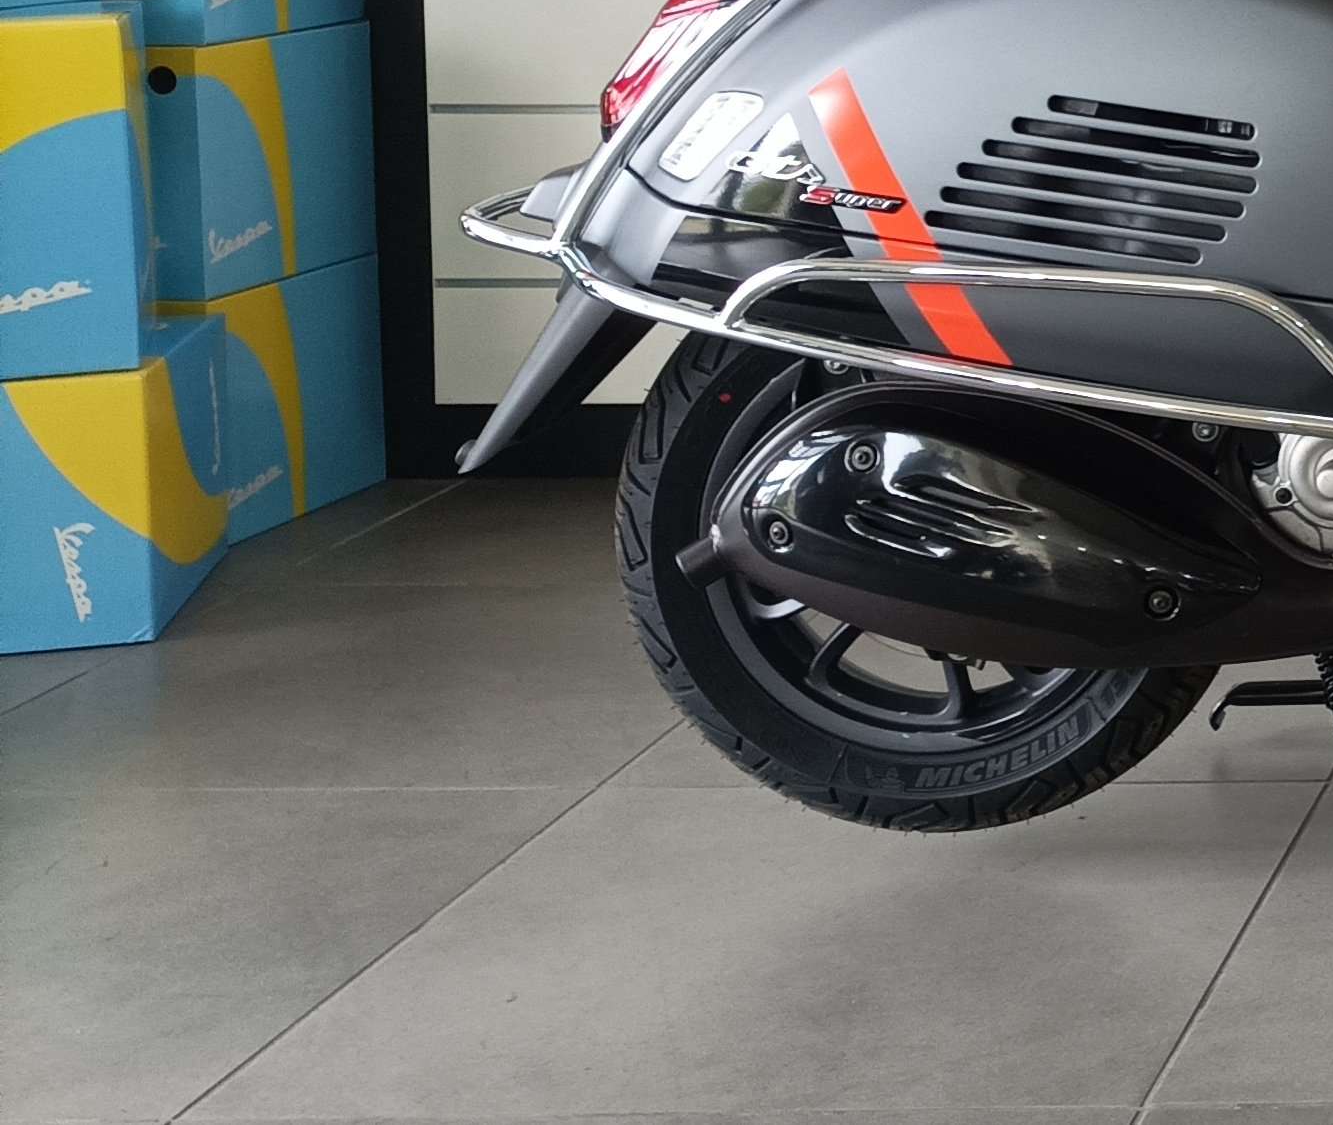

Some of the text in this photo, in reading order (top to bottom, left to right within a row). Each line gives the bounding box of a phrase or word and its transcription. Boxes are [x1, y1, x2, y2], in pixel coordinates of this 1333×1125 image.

[799, 186, 903, 211] Super
[53, 522, 95, 624] Vespa
[914, 713, 1081, 788] MICHELIN
